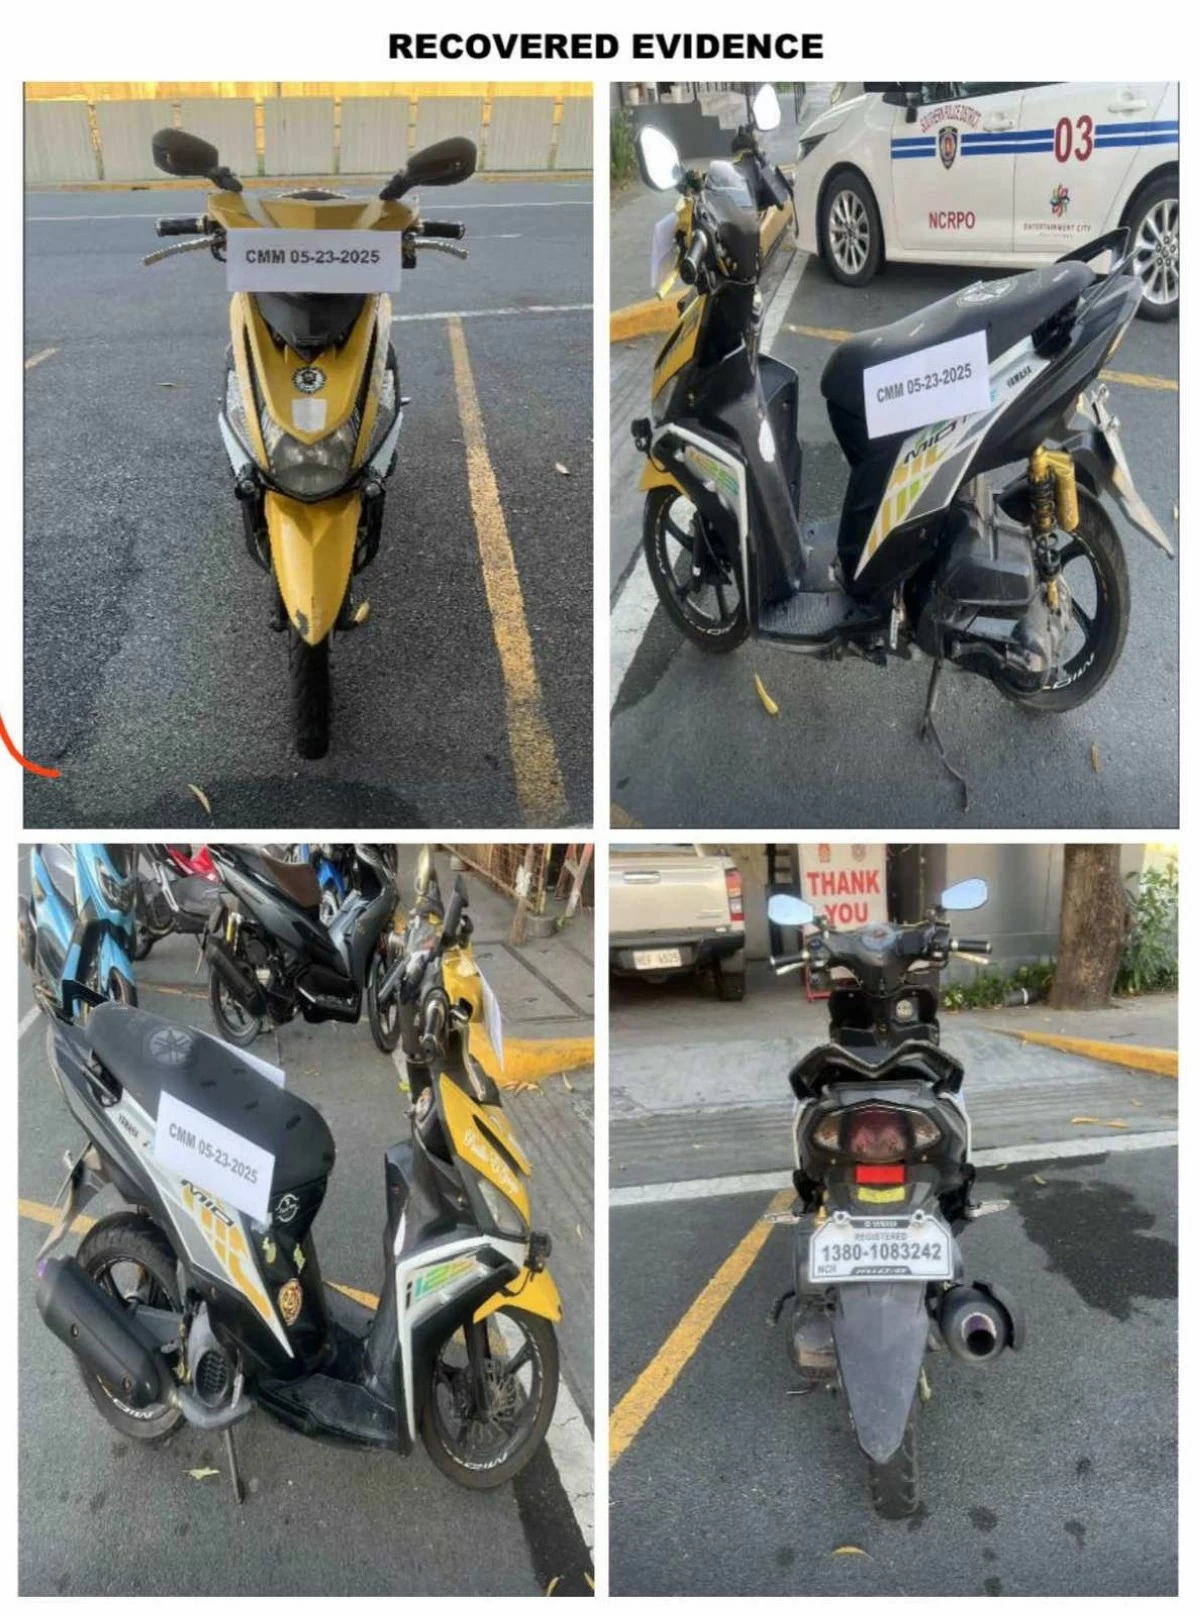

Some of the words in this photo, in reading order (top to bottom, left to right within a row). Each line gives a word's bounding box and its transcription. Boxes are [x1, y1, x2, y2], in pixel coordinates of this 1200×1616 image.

[1055, 115, 1093, 163] 03
[928, 211, 976, 230] NCRPO
[1076, 223, 1092, 232] CITY
[245, 249, 286, 264] CMM
[290, 249, 381, 264] 05-23-2025
[876, 381, 905, 403] CMM
[907, 363, 973, 395] 05-23-2025
[1006, 365, 1033, 389] YAMAHA
[806, 869, 880, 897] THANK
[824, 902, 869, 930] YOU
[168, 1122, 196, 1149] CMM
[198, 1139, 259, 1184] 05-23-2025
[854, 1232, 908, 1241] REGISTERED
[822, 1243, 942, 1261] 1380-1083242
[817, 1265, 837, 1274] NCR
